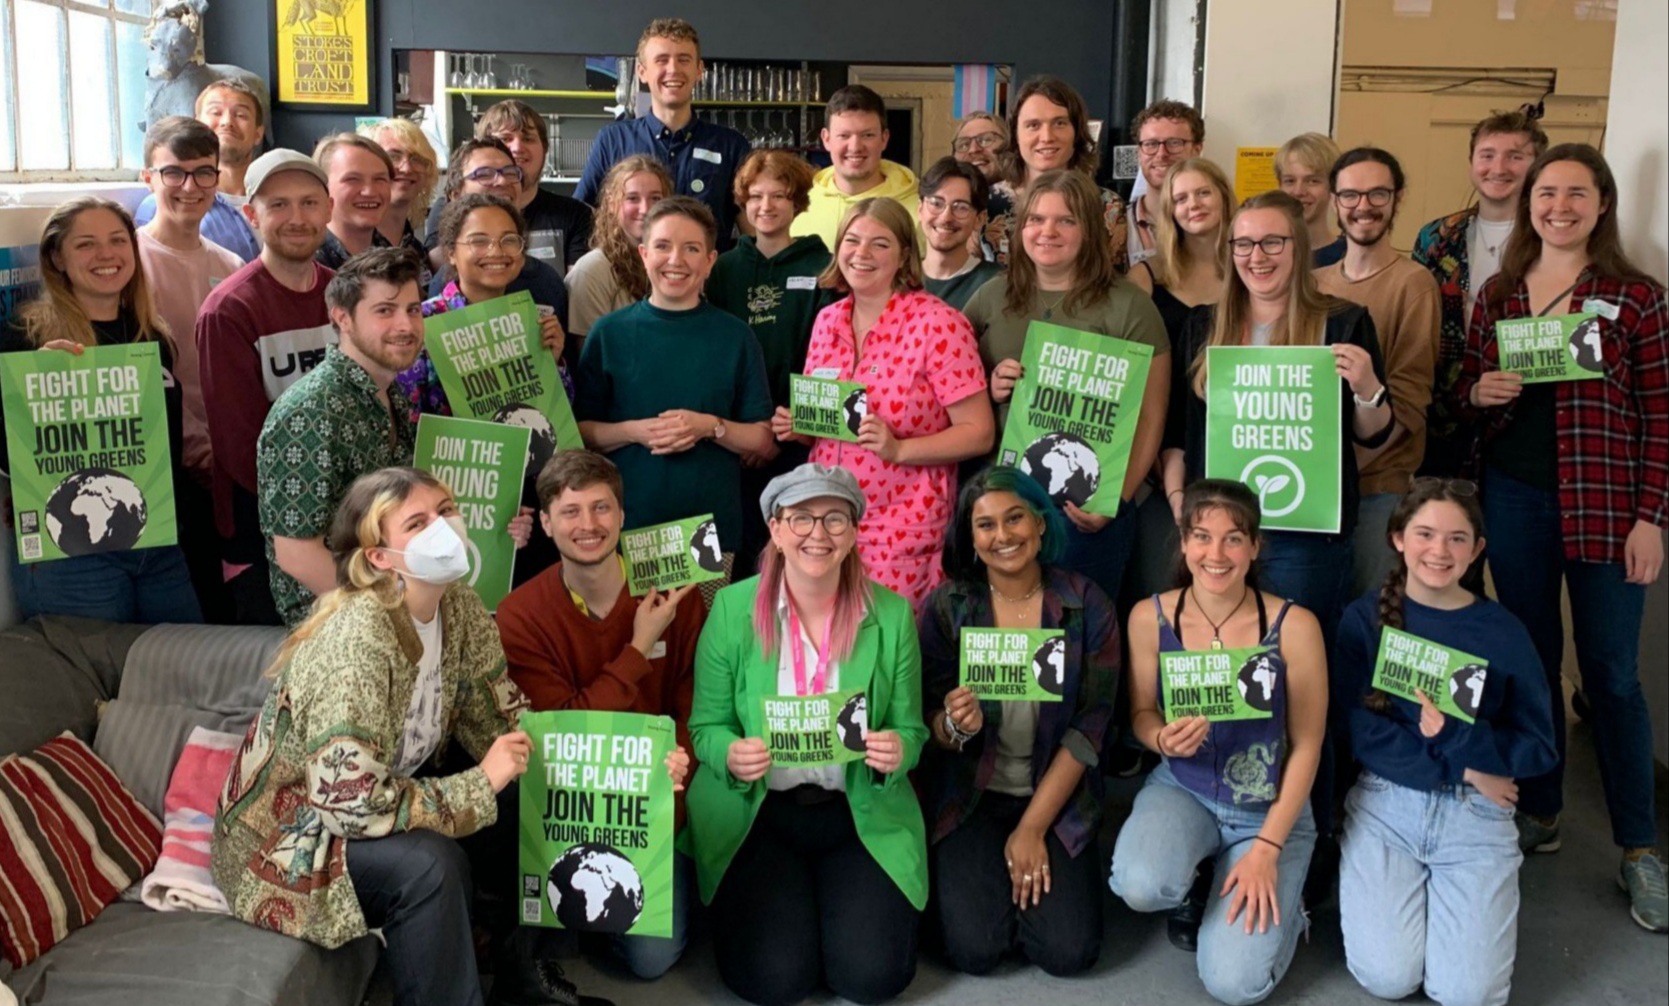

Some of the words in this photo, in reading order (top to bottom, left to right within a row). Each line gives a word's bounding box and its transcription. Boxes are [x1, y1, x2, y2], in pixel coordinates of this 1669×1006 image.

[293, 35, 352, 48] STOKES
[293, 48, 353, 63] CROFT
[294, 63, 353, 79] LAND
[294, 80, 354, 93] TRUST
[440, 322, 489, 355] FIGHT
[489, 312, 525, 340] FOR
[1501, 322, 1535, 340] FIGHT
[1538, 320, 1563, 336] FOR
[449, 351, 479, 375] THE
[478, 334, 529, 366] PLANET
[1503, 340, 1523, 353] THE
[1524, 336, 1563, 351] PLANET
[1039, 341, 1093, 373] FIGHT
[1093, 353, 1129, 381] FOR
[1505, 351, 1535, 370] JOIN
[1537, 348, 1566, 367] THE
[25, 368, 91, 400] FIGHT
[96, 365, 140, 394] FOR
[461, 367, 501, 402] JOIN
[498, 354, 539, 387] THE
[1037, 364, 1066, 388] THE
[1067, 372, 1125, 401] PLANET
[1232, 364, 1272, 387] JOIN
[1276, 364, 1313, 388] THE
[1535, 366, 1567, 378] GREENS
[468, 395, 503, 418] YOUNG
[503, 381, 544, 405] GREENS
[793, 378, 819, 394] FIGHT
[821, 382, 840, 398] FOR
[28, 399, 67, 424] THE
[71, 393, 141, 420] PLANET
[794, 393, 809, 406] THE
[810, 395, 839, 410] PLANET
[1029, 385, 1076, 418] JOIN
[1079, 396, 1120, 428] THE
[1232, 390, 1313, 422] YOUNG
[794, 405, 816, 422] JOIN
[819, 408, 840, 426] THE
[33, 422, 88, 456] JOIN
[94, 417, 145, 449] THE
[1028, 411, 1065, 432] YOUNG
[1069, 420, 1114, 444] GREENS
[1231, 424, 1314, 451] GREENS
[34, 454, 85, 475] YOUNG
[89, 448, 147, 470] GREENS
[431, 435, 466, 462] JOIN
[470, 439, 504, 466] THE
[453, 502, 496, 530] ENS
[625, 530, 658, 550] FIGHT
[660, 525, 684, 542] FOR
[627, 547, 648, 562] THE
[648, 540, 685, 557] PLANET
[632, 560, 660, 580] JOIN
[662, 553, 689, 573] THE
[633, 578, 660, 590] YOUNG
[661, 570, 691, 585] GREENS
[965, 632, 1002, 650] FIGHT
[1004, 633, 1028, 650] FOR
[1385, 632, 1423, 656] FIGHT
[1424, 645, 1450, 667] FOR
[965, 650, 987, 664] THE
[988, 650, 1028, 664] PLANET
[1165, 656, 1202, 673] FIGHT
[1205, 654, 1231, 671] FOR
[1385, 646, 1406, 664] THE
[1406, 652, 1448, 679] PLANET
[965, 665, 996, 683] JOIN
[999, 665, 1027, 683] THE
[1167, 674, 1189, 687] THE
[1190, 671, 1231, 686] PLANET
[1380, 676, 1406, 693] YOUNG
[1381, 660, 1413, 683] JOIN
[1416, 671, 1445, 695] THE
[995, 684, 1027, 695] GREENS
[1170, 688, 1201, 706] JOIN
[1204, 686, 1234, 704] THE
[765, 699, 801, 717] FIGHT
[804, 699, 830, 716] FOR
[1170, 706, 1200, 718] YOUNG
[1201, 704, 1235, 716] GREENS
[767, 716, 788, 731] THE
[789, 716, 830, 731] PLANET
[543, 732, 606, 763] FIGHT
[611, 734, 653, 766] FOR
[769, 732, 799, 750] JOIN
[803, 730, 832, 750] THE
[800, 750, 834, 762] GREENS
[545, 763, 578, 788] THE
[582, 765, 651, 793] PLANET
[542, 788, 594, 824] JOIN
[602, 793, 650, 828] THE
[542, 823, 590, 844] YOUNG
[593, 826, 649, 849] GREENS
